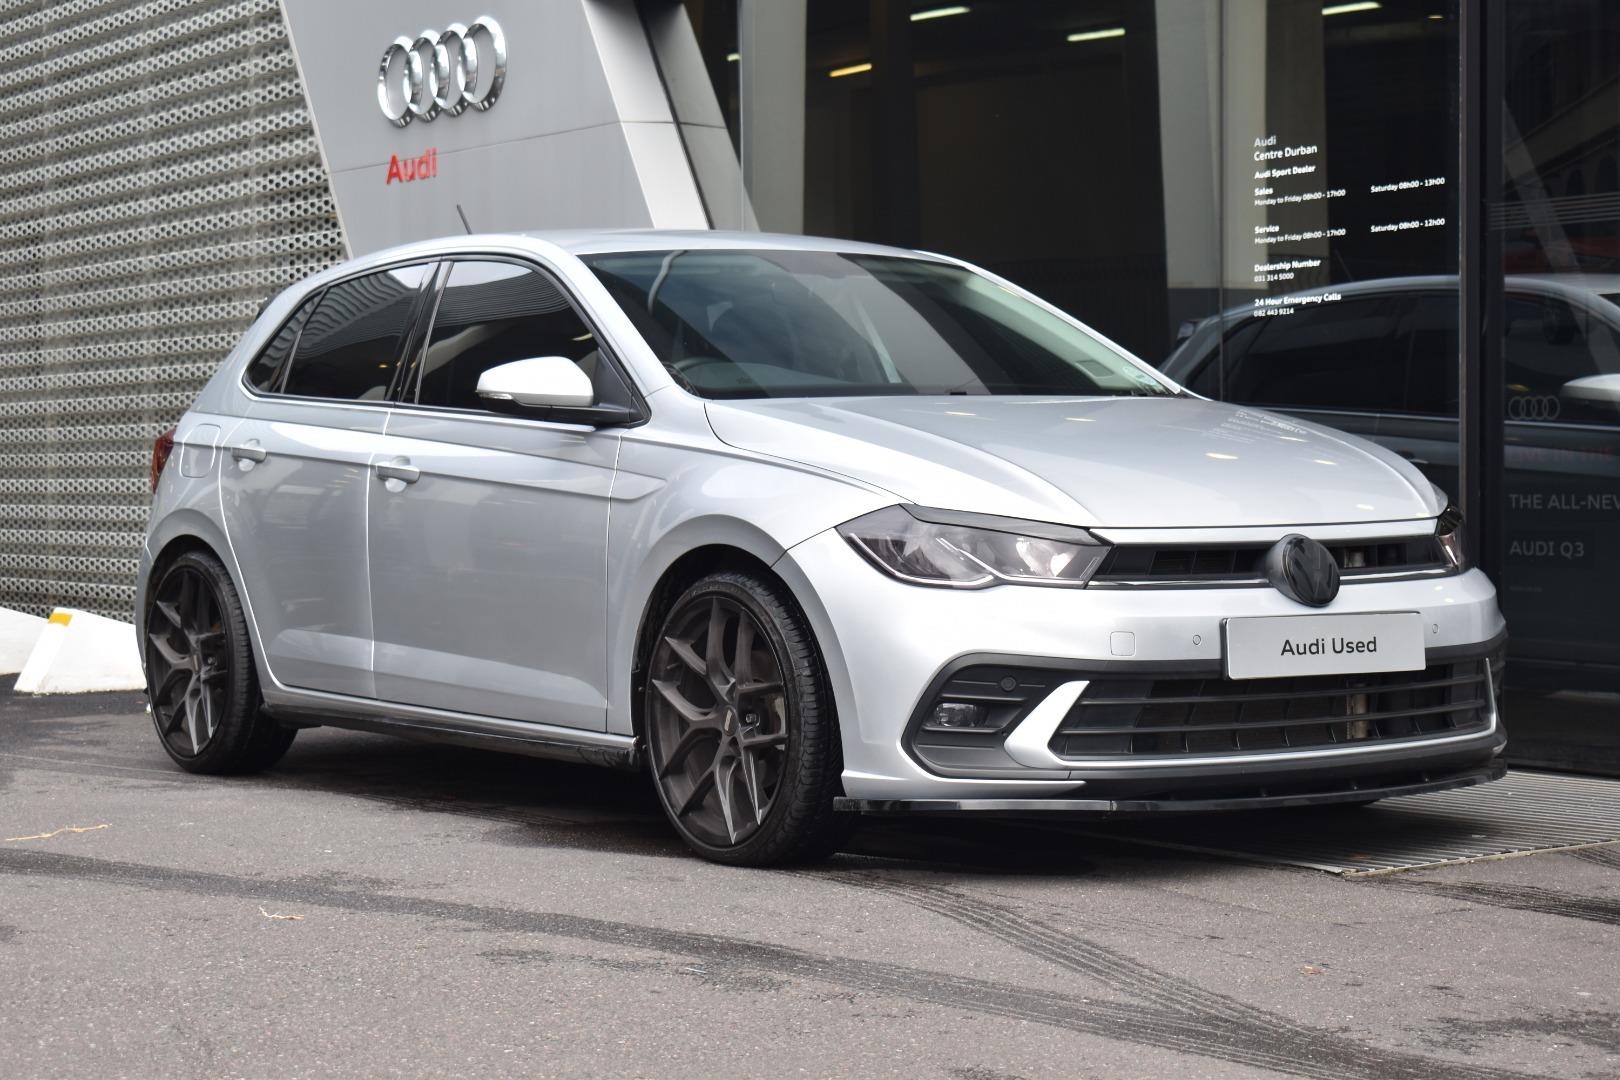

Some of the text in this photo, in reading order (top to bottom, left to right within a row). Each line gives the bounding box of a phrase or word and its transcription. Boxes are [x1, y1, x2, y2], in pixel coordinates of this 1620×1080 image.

[1254, 136, 1276, 147] Audi
[1253, 145, 1317, 161] Centre Durban
[386, 147, 437, 185] Audi
[1254, 165, 1316, 179] Audi Sport Dealer
[1254, 187, 1274, 196] Sales
[1370, 184, 1398, 193] Saturday
[1254, 198, 1276, 206] Monday
[1284, 194, 1302, 202] Friday
[1326, 189, 1346, 198] 17h00
[1254, 225, 1280, 234] Service
[1370, 224, 1398, 233] Saturday
[1424, 218, 1445, 227] 12h00
[1254, 236, 1276, 244] Monday
[1284, 233, 1302, 241] Friday
[1326, 228, 1346, 237] 17h00
[1254, 259, 1321, 272] Dealership Number
[1278, 272, 1294, 280] 5000
[1254, 293, 1342, 307] 24 Hour Emergency Calls
[1508, 494, 1543, 509] THE
[1508, 541, 1585, 559] AUDI Q3
[1280, 636, 1377, 656] Audi Used
